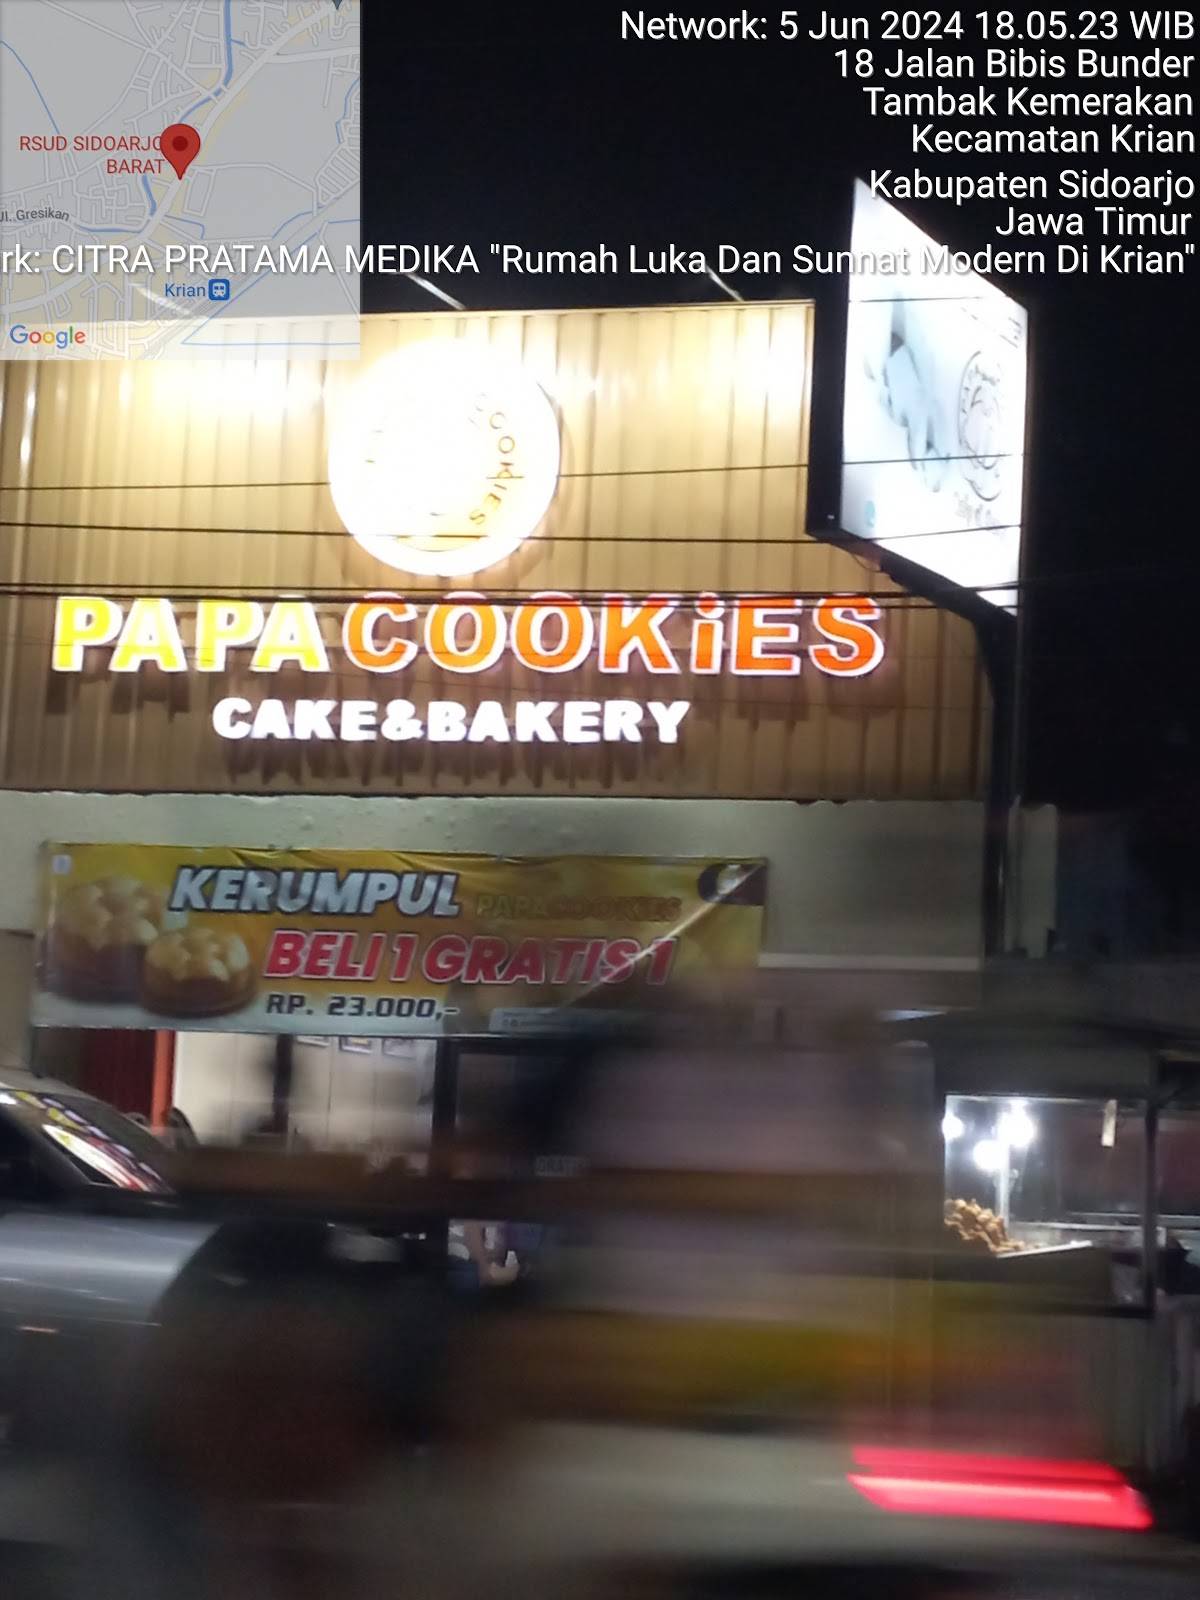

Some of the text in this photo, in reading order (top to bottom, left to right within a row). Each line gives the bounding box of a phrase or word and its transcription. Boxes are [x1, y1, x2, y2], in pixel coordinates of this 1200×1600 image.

[52, 595, 331, 672] PAPA
[212, 697, 691, 743] CAKE&BAKERY
[168, 867, 461, 917] KERUMPUL
[263, 930, 679, 986] BELI 1 GRATIS 1
[265, 993, 461, 1020] RP. 23.000,-
